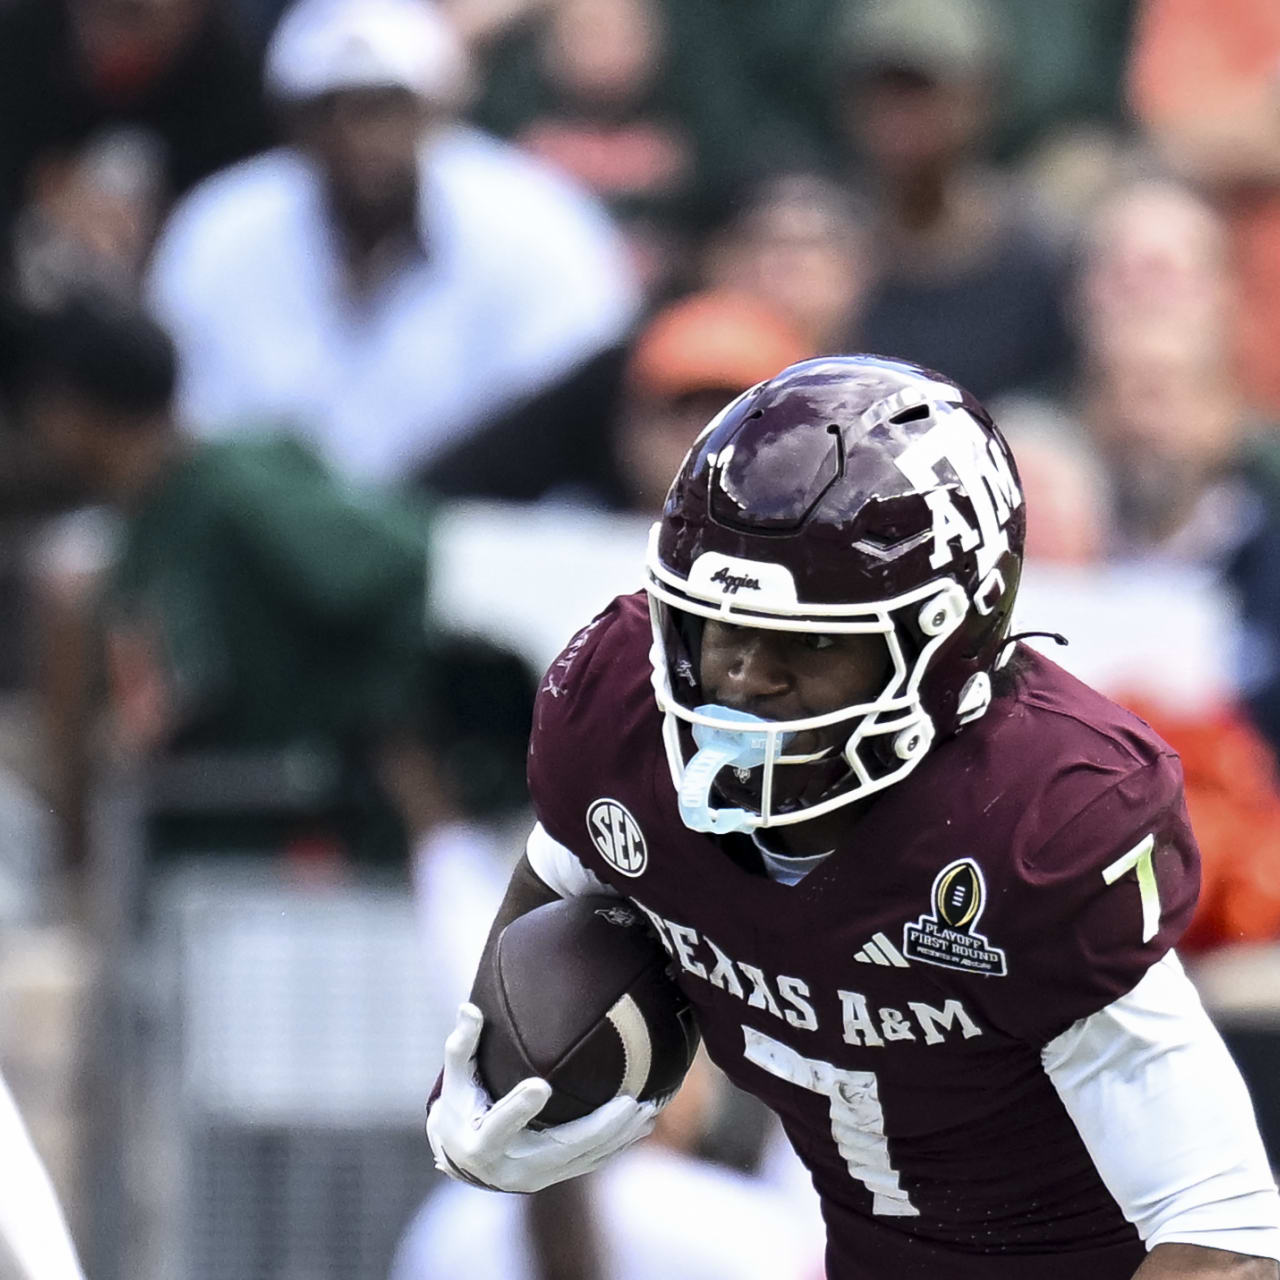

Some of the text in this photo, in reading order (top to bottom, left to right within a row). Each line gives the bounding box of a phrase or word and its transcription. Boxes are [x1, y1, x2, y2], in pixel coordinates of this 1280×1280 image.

[710, 567, 762, 595] Aggies
[592, 804, 643, 872] SEC
[1101, 833, 1162, 944] 7
[910, 930, 999, 963] FIRST ROUND
[925, 922, 982, 949] PLAYOFF
[629, 896, 982, 1048] TEXAS A&M
[741, 1024, 920, 1217] 7
